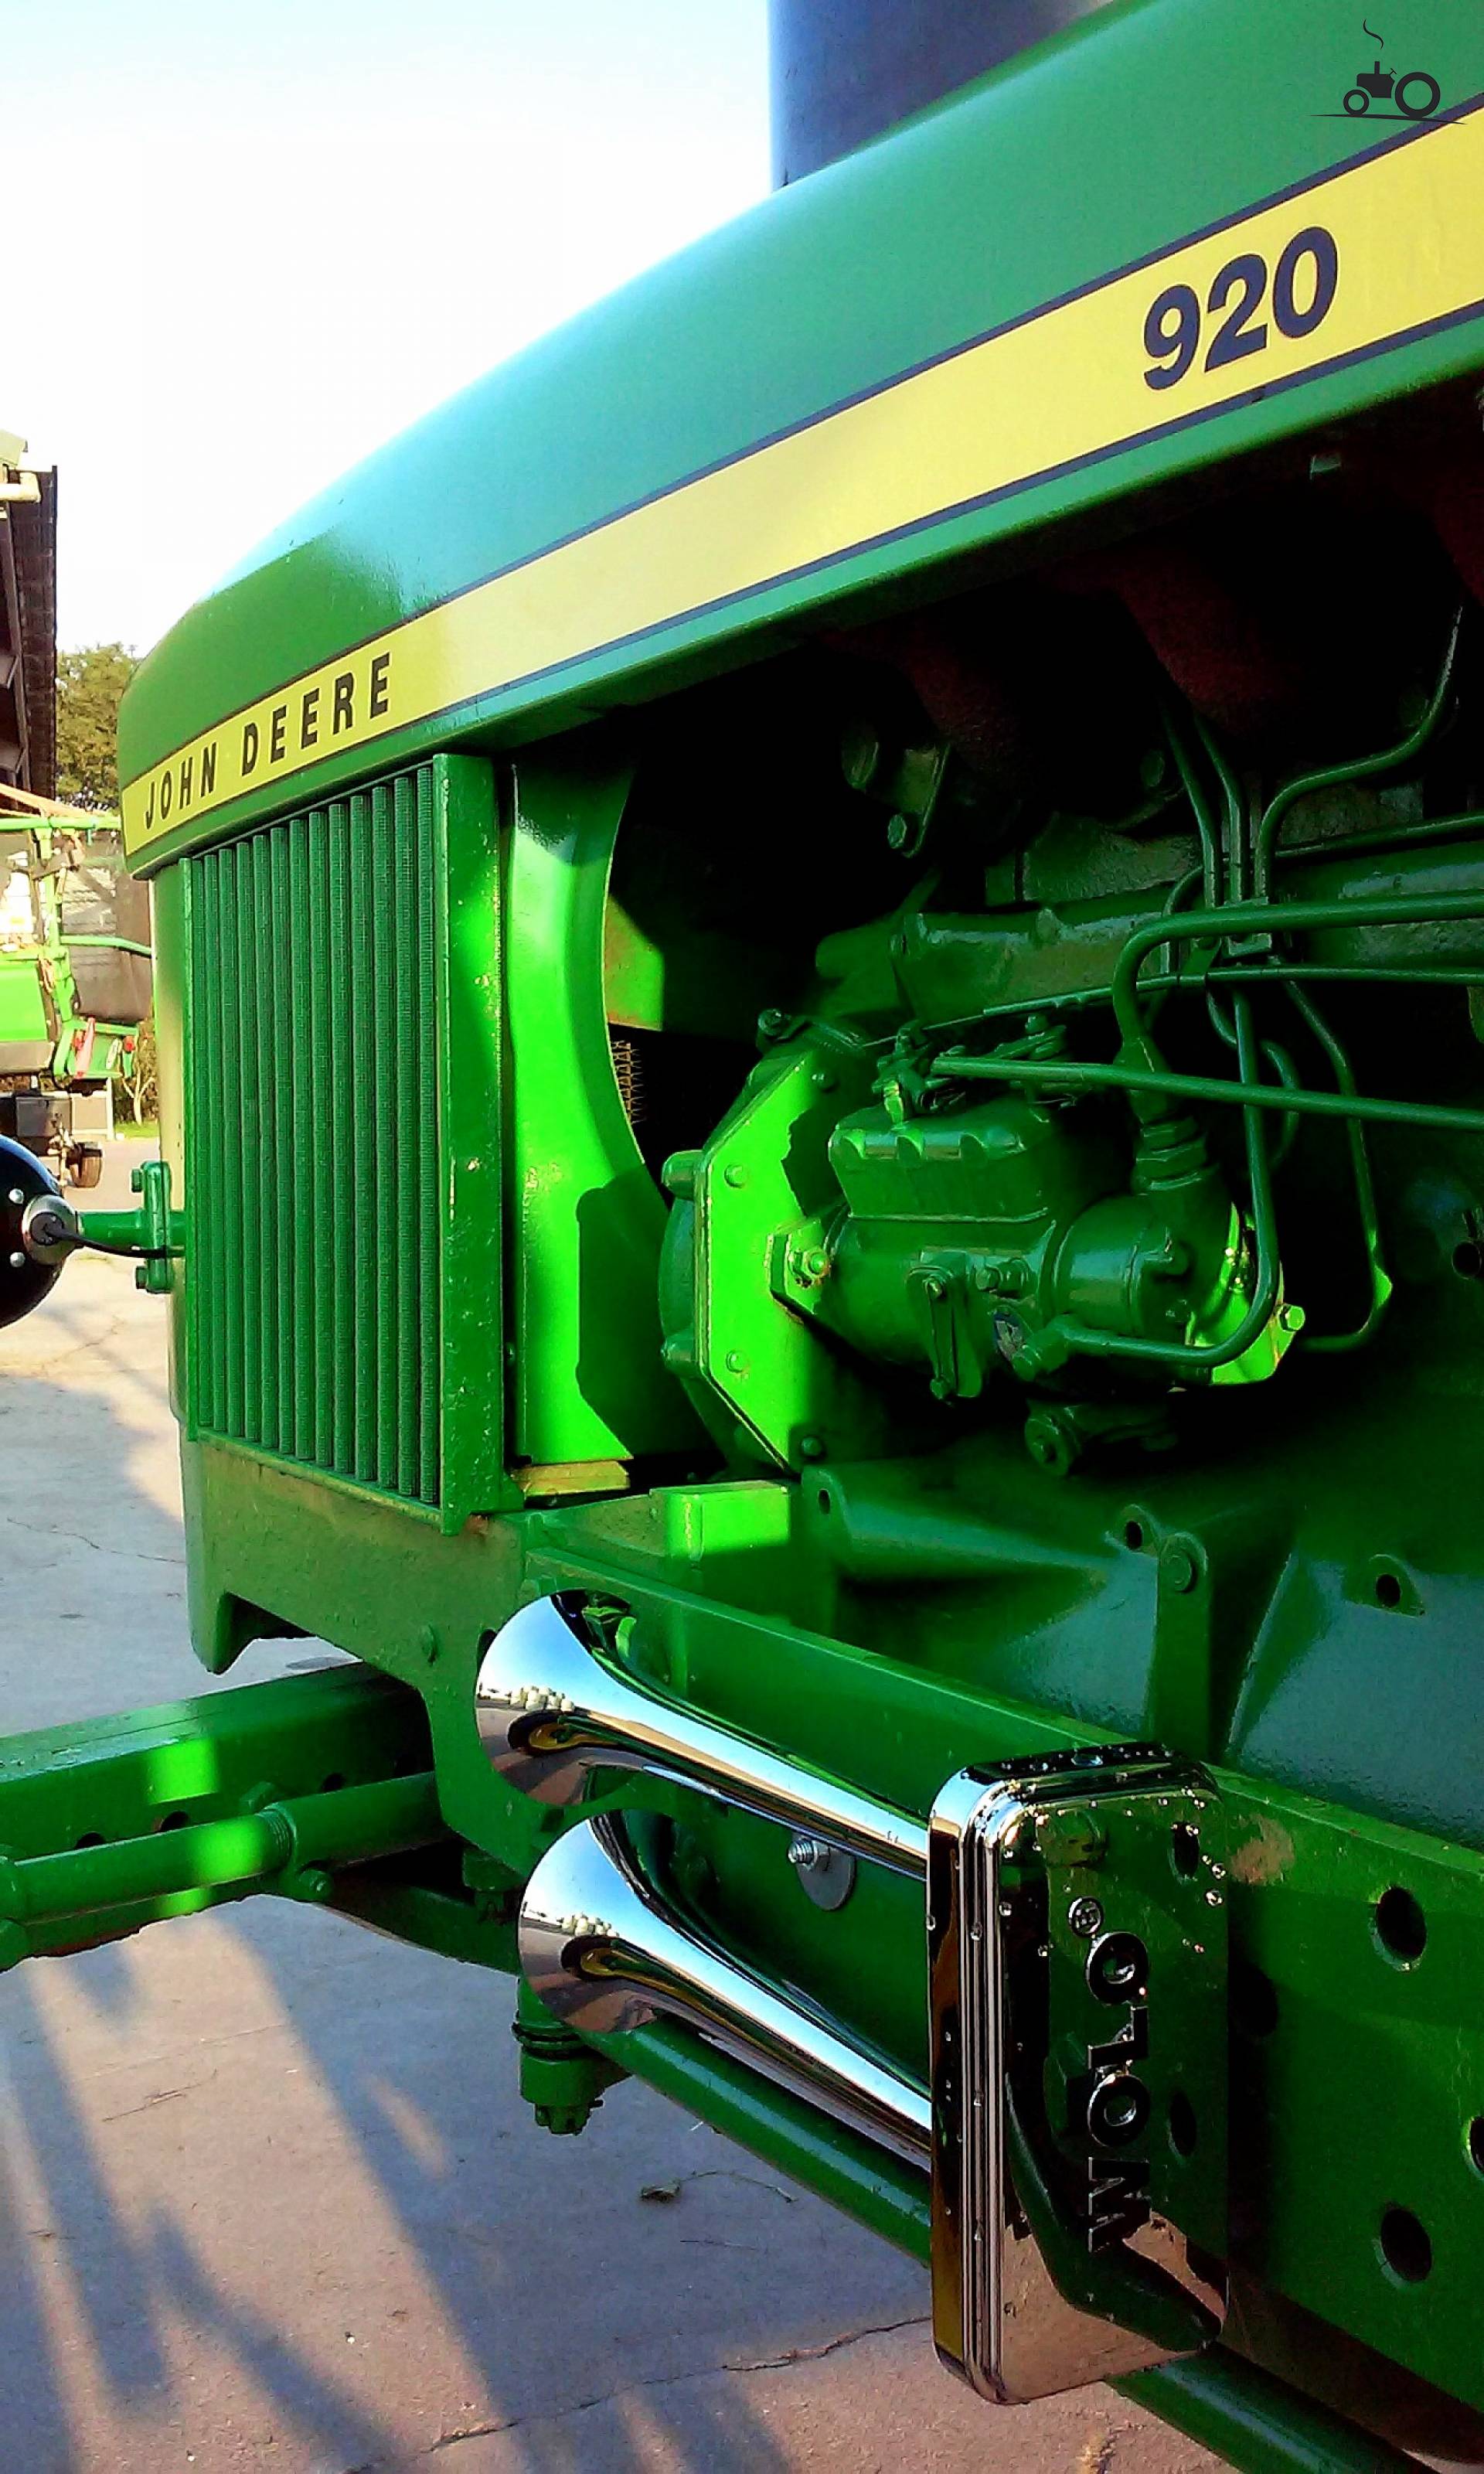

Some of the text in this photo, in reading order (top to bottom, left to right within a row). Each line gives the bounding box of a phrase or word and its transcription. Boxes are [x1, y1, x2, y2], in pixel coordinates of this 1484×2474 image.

[1144, 226, 1338, 390] 920
[145, 653, 390, 830] JOHN DEERE
[1086, 1931, 1150, 2253] WOLO
